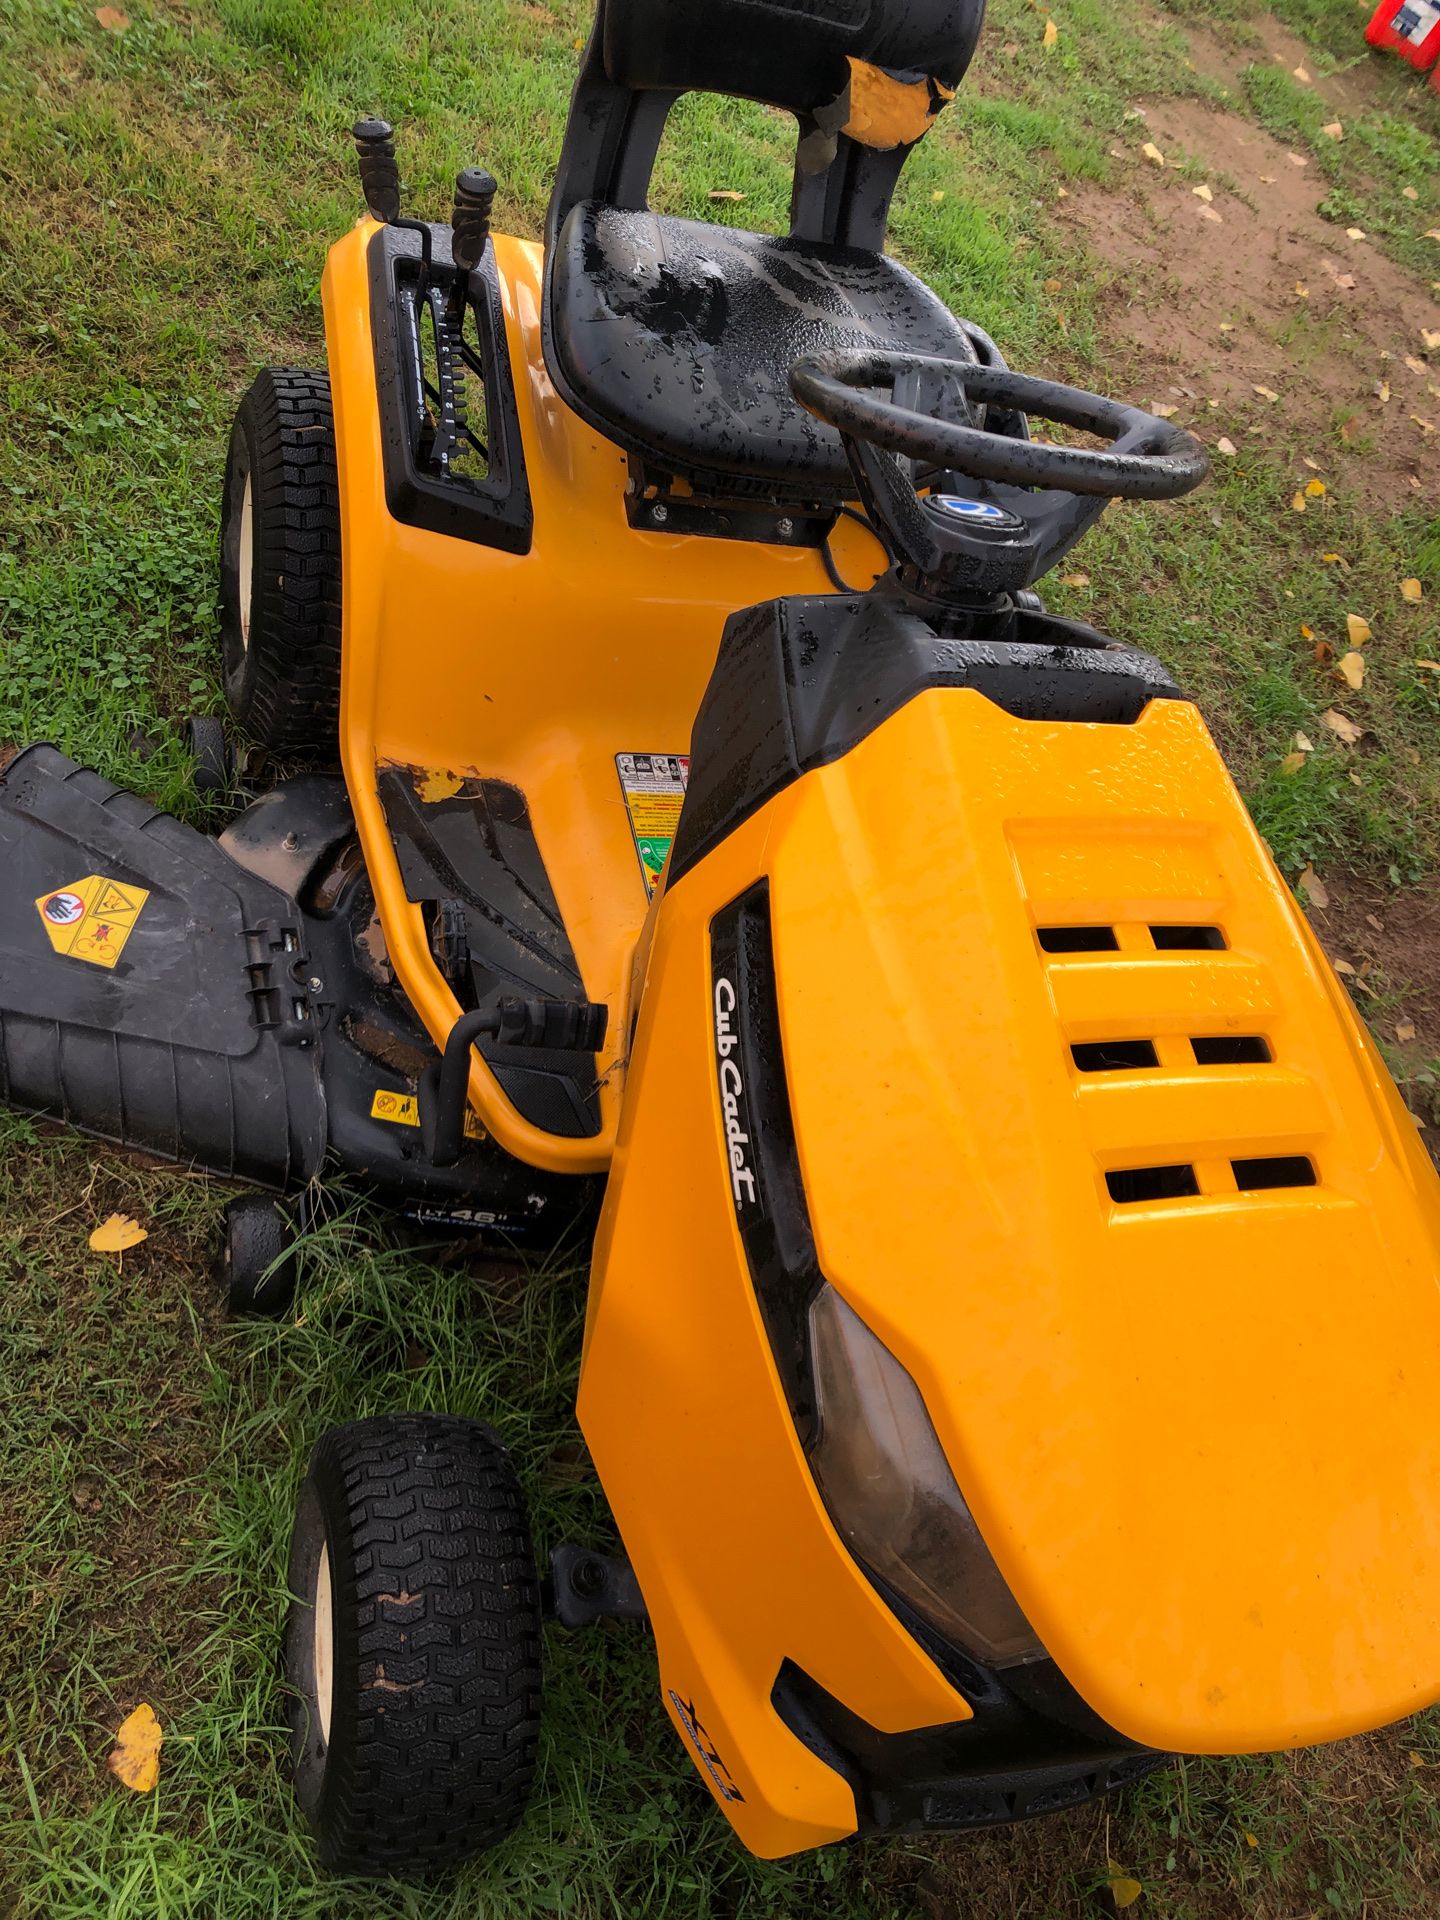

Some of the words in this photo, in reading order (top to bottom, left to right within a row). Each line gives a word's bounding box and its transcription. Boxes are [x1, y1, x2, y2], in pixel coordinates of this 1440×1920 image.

[445, 401, 453, 409] 2
[441, 452, 448, 464] LO
[715, 978, 738, 1057] Cub
[720, 1059, 756, 1205] Cadet
[425, 1208, 446, 1217] LT
[676, 1693, 747, 1804] XT1
